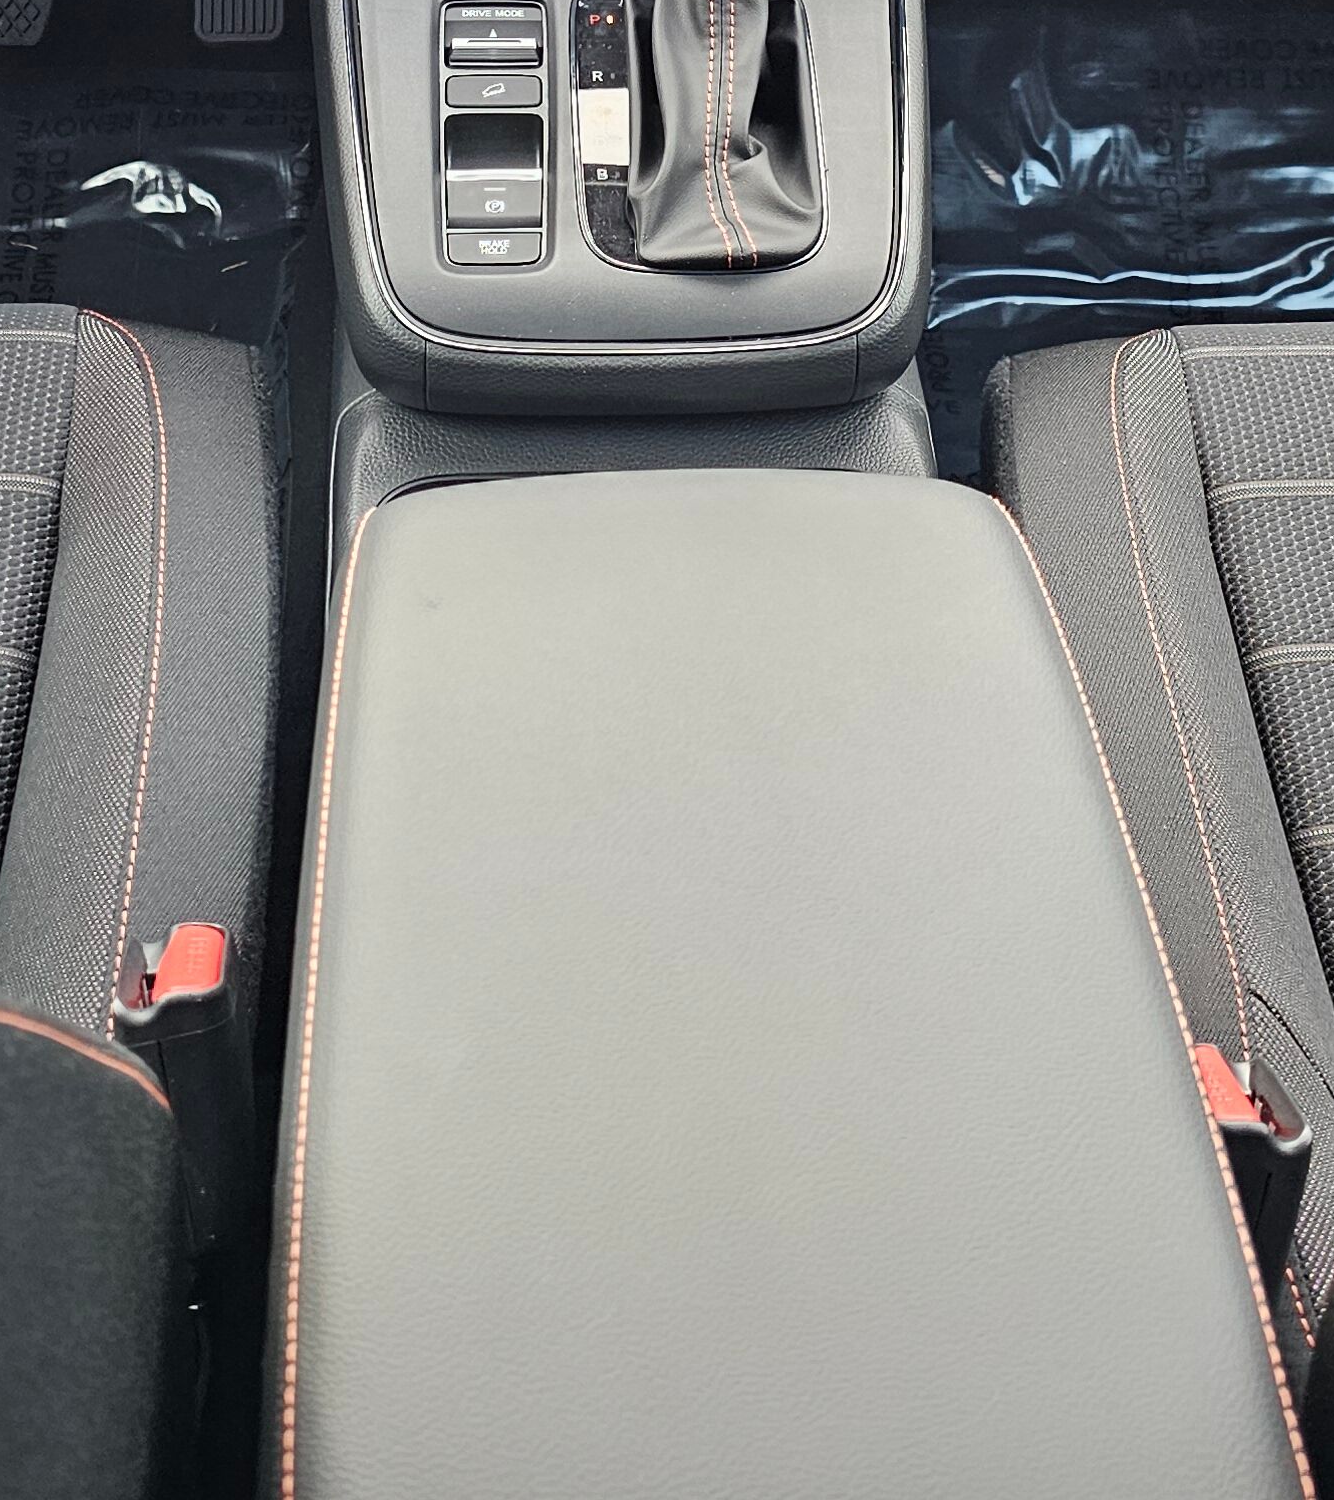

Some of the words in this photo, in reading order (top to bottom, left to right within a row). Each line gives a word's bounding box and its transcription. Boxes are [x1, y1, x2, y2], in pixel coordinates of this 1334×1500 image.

[461, 9, 491, 18] DRIVE
[495, 9, 524, 18] MODE
[589, 14, 601, 25] P
[591, 70, 604, 82] R
[596, 168, 609, 181] B
[478, 240, 510, 249] BRAKE
[480, 247, 508, 255] HOLD
